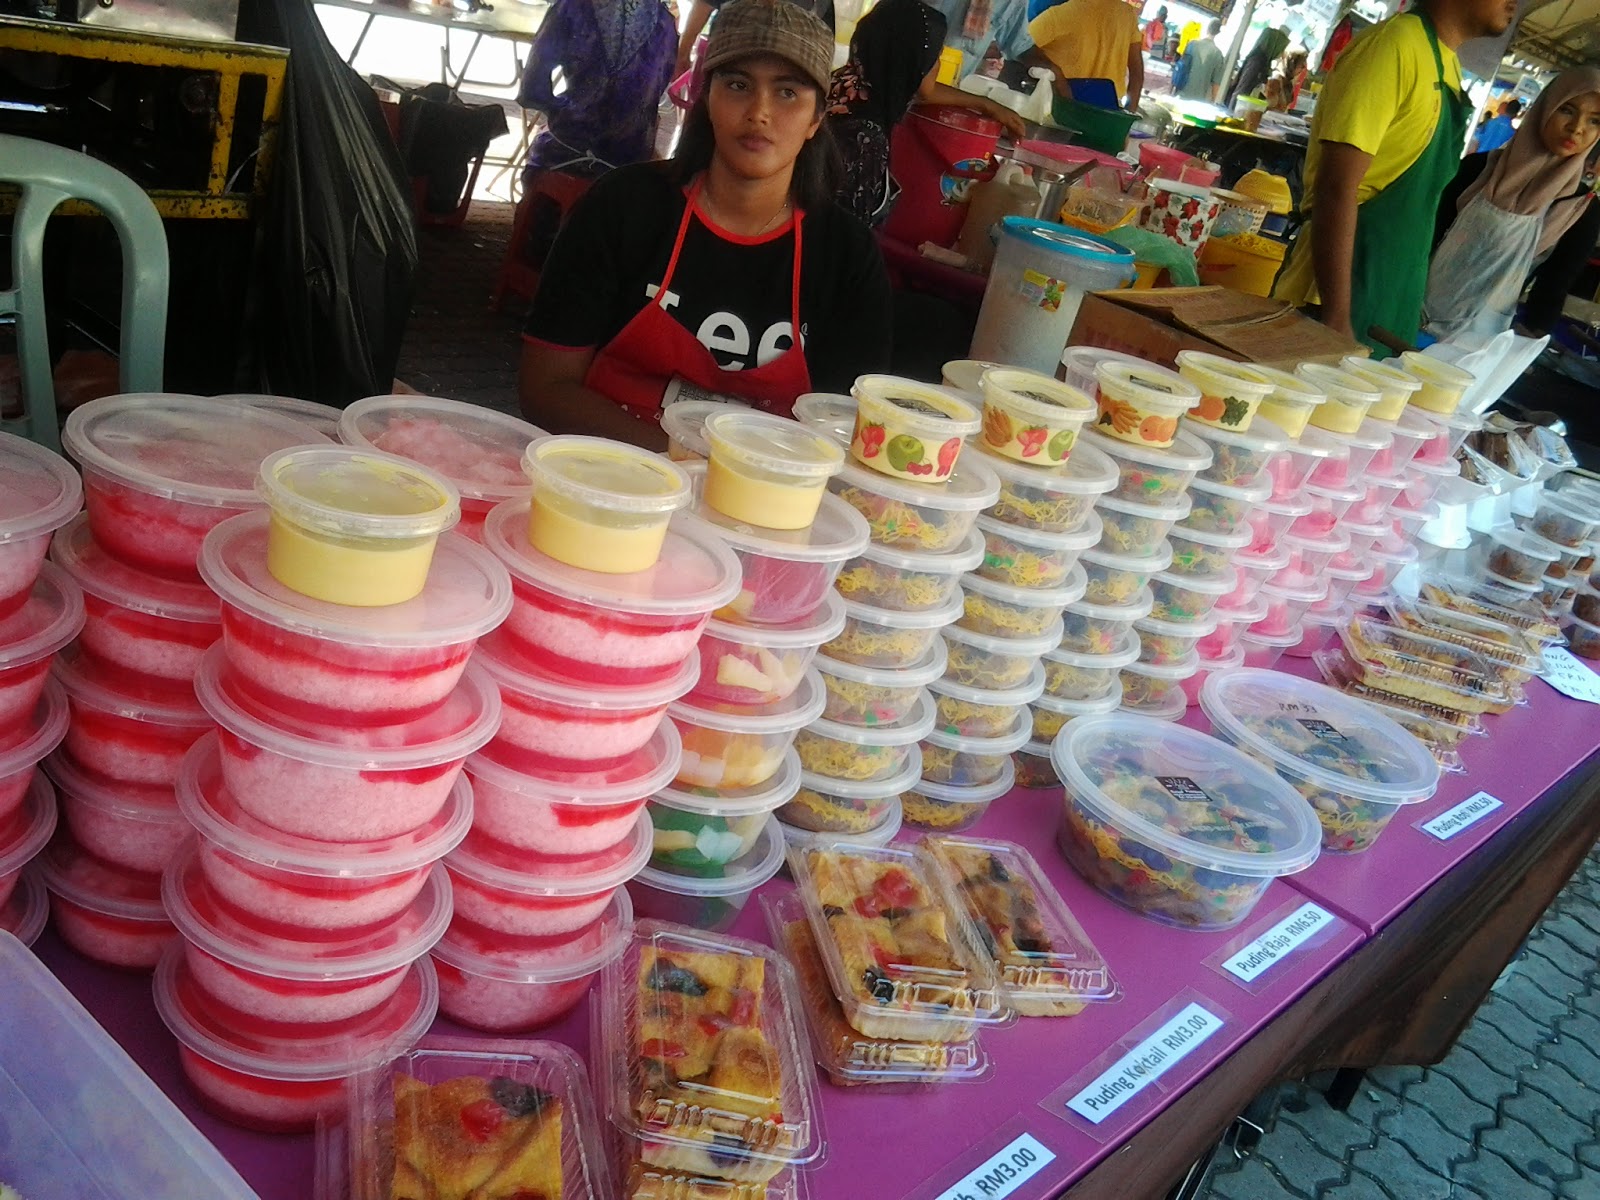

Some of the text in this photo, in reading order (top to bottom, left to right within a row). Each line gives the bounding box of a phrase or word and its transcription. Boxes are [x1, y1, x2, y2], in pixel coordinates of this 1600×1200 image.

[645, 283, 805, 372] ee
[1235, 910, 1322, 973] Puding Raja RM6.50
[1083, 1014, 1208, 1111] Puding Koktail RM3.00
[975, 1147, 1037, 1196] RM3.00
